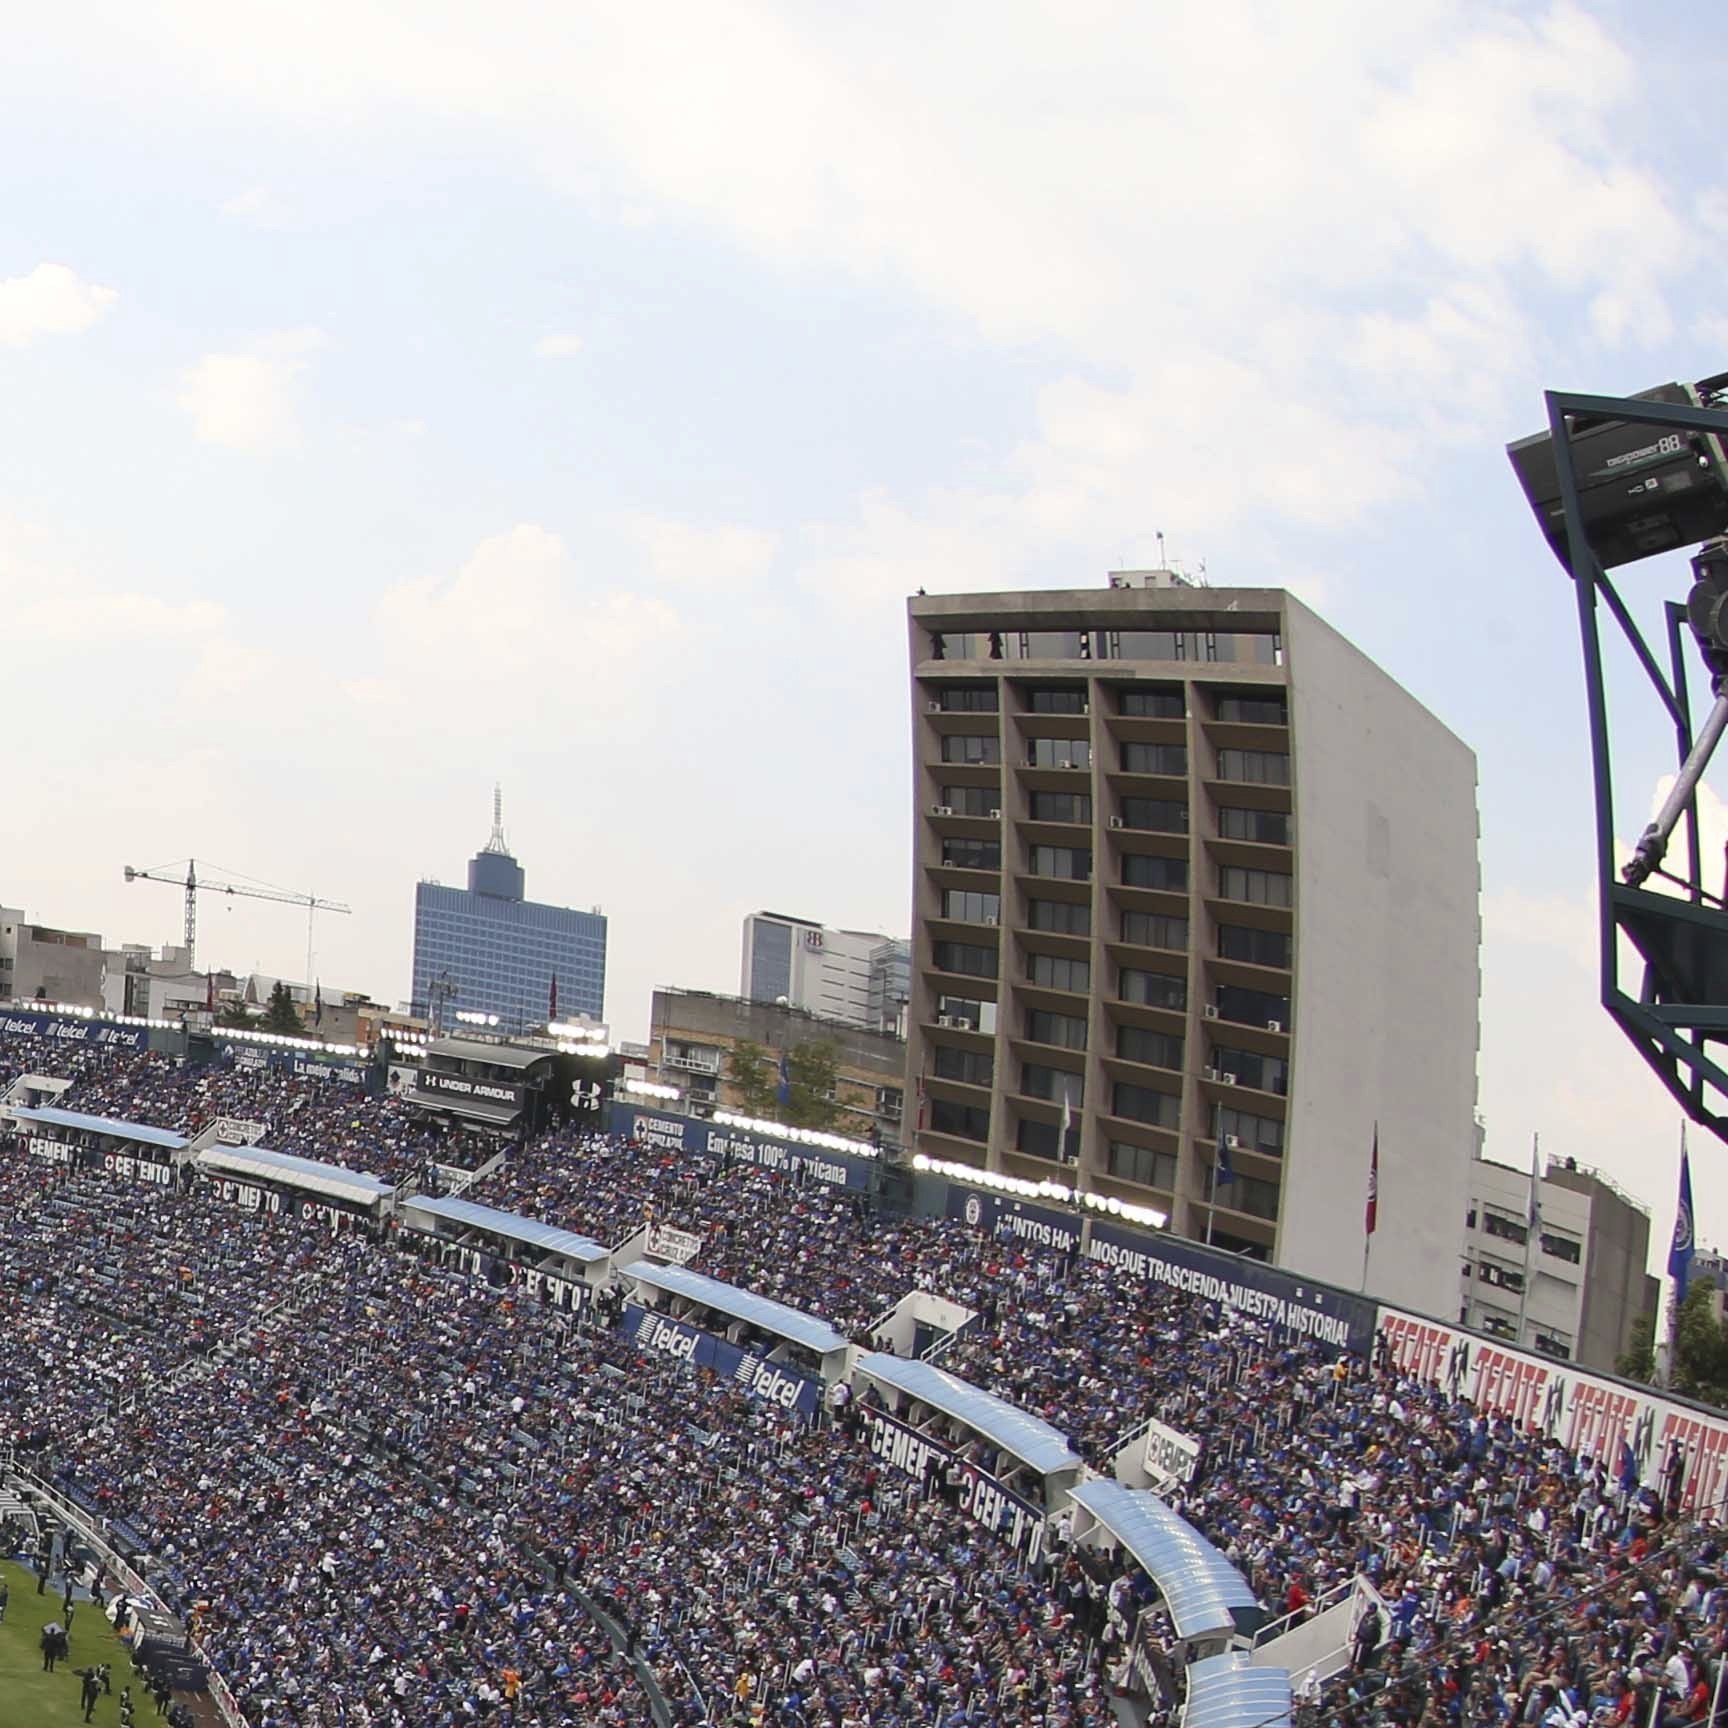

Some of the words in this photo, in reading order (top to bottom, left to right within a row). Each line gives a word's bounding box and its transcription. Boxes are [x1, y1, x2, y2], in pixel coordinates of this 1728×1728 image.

[5, 1019, 33, 1034] telcel
[56, 1022, 89, 1040] telcel
[440, 1078, 472, 1094] UNDER
[473, 1085, 516, 1101] ARMOUR
[648, 1117, 685, 1136] CEMENTO
[757, 1142, 789, 1170] 100%
[1052, 1230, 1120, 1266] HAMOS
[1119, 1247, 1148, 1275] QUE
[1147, 1256, 1228, 1303] TRASCIENDA
[1286, 1302, 1349, 1348] HISTORIA!
[651, 1319, 700, 1362] telcel
[751, 1362, 805, 1409] telcel
[1469, 1347, 1549, 1438] TECATE
